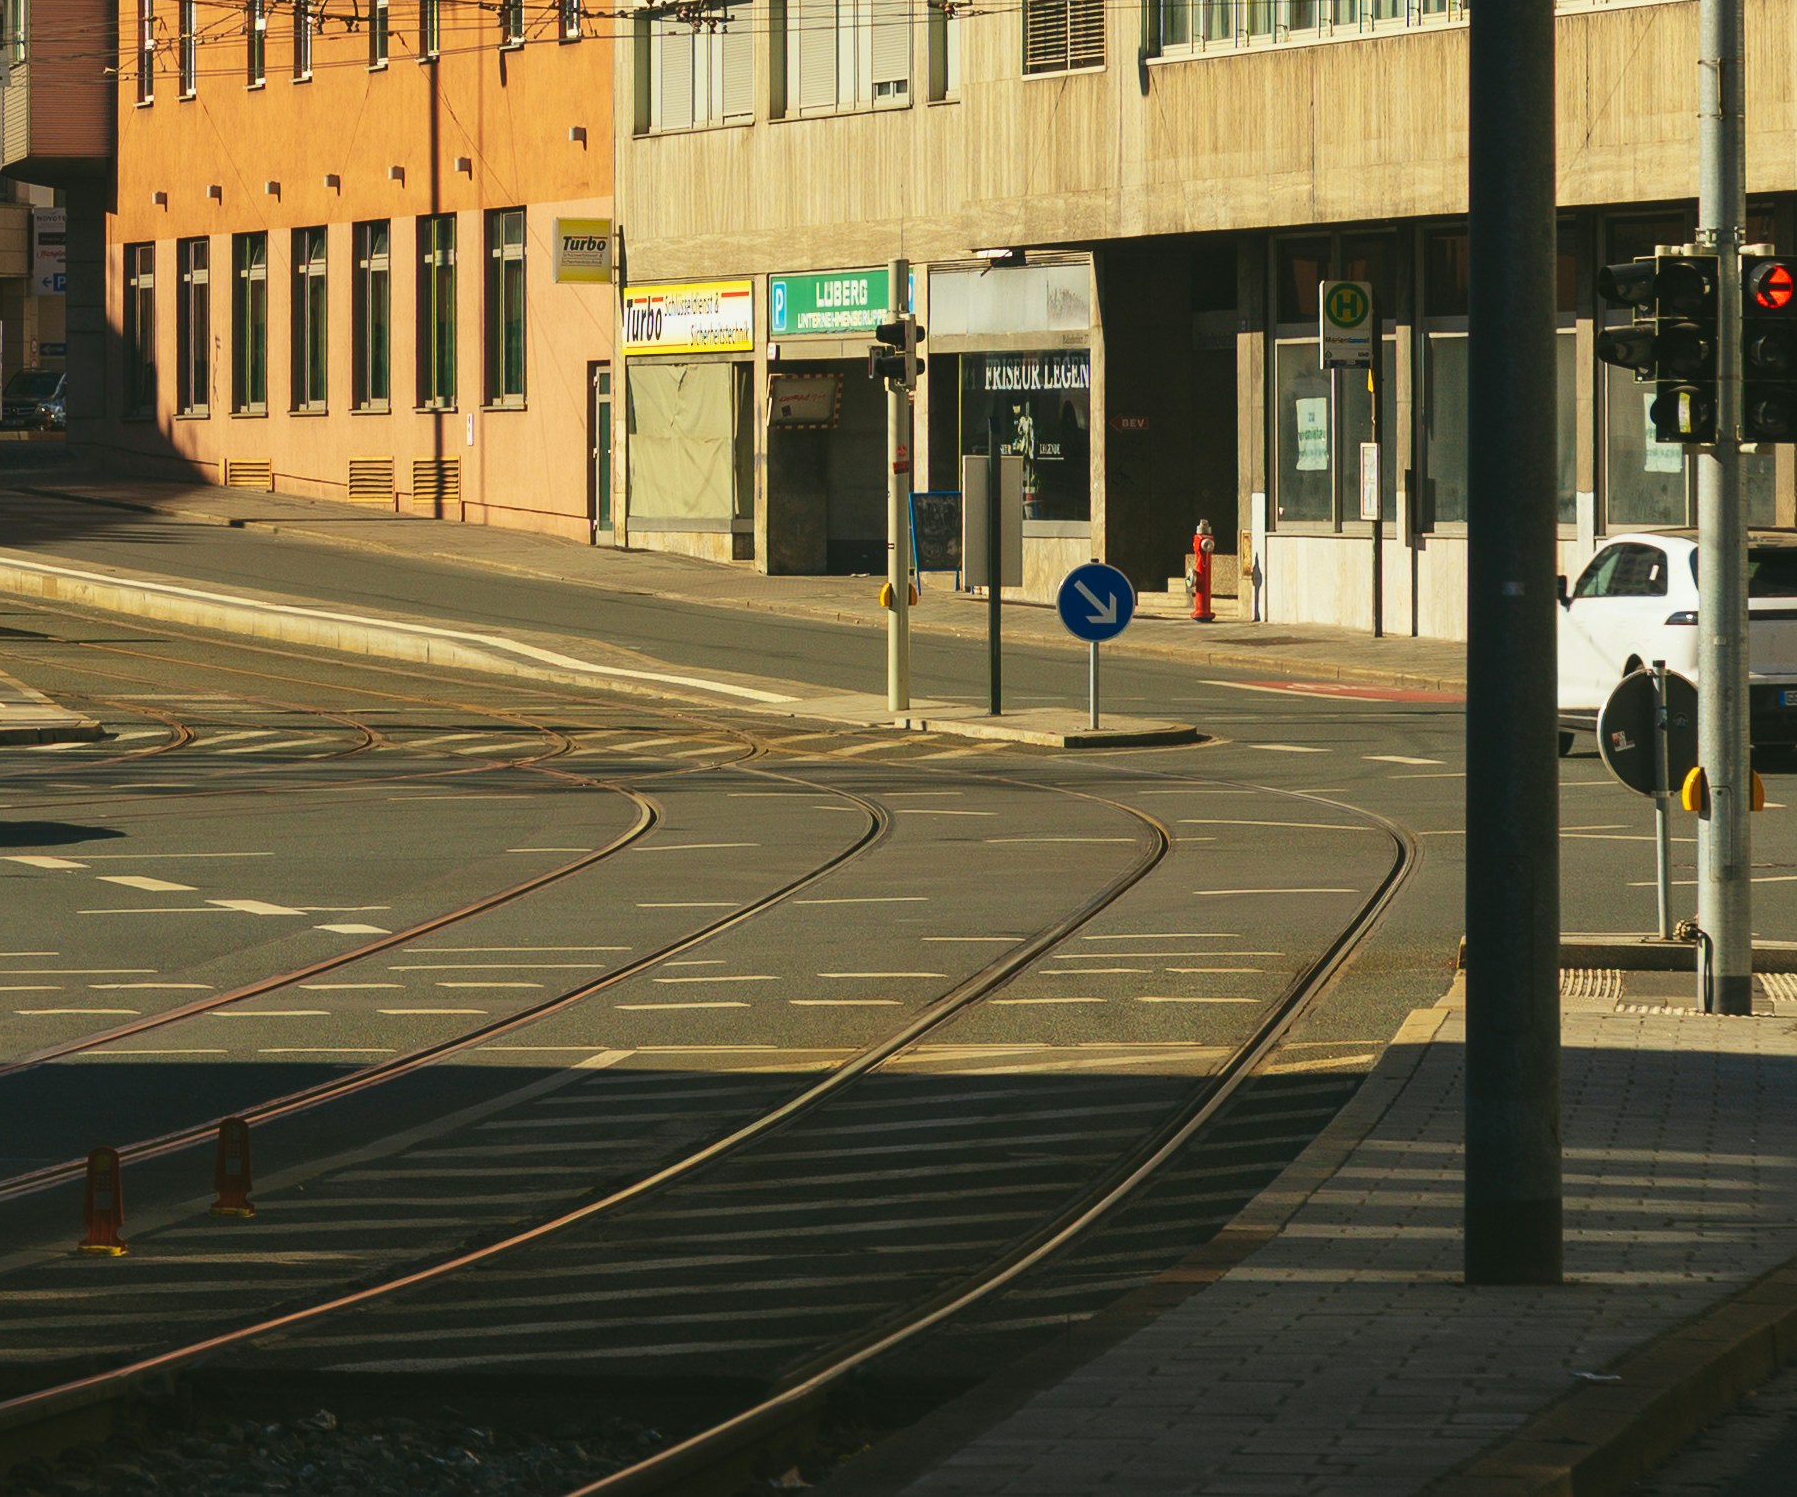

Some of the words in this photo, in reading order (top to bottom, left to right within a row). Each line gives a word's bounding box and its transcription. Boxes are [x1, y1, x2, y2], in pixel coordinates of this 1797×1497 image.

[563, 235, 606, 251] Turbo
[57, 276, 66, 289] P
[775, 288, 783, 325] P
[1336, 293, 1358, 318] H
[626, 296, 662, 343] Turbo
[985, 364, 1041, 391] FRISEUR
[1122, 418, 1145, 428] BEV
